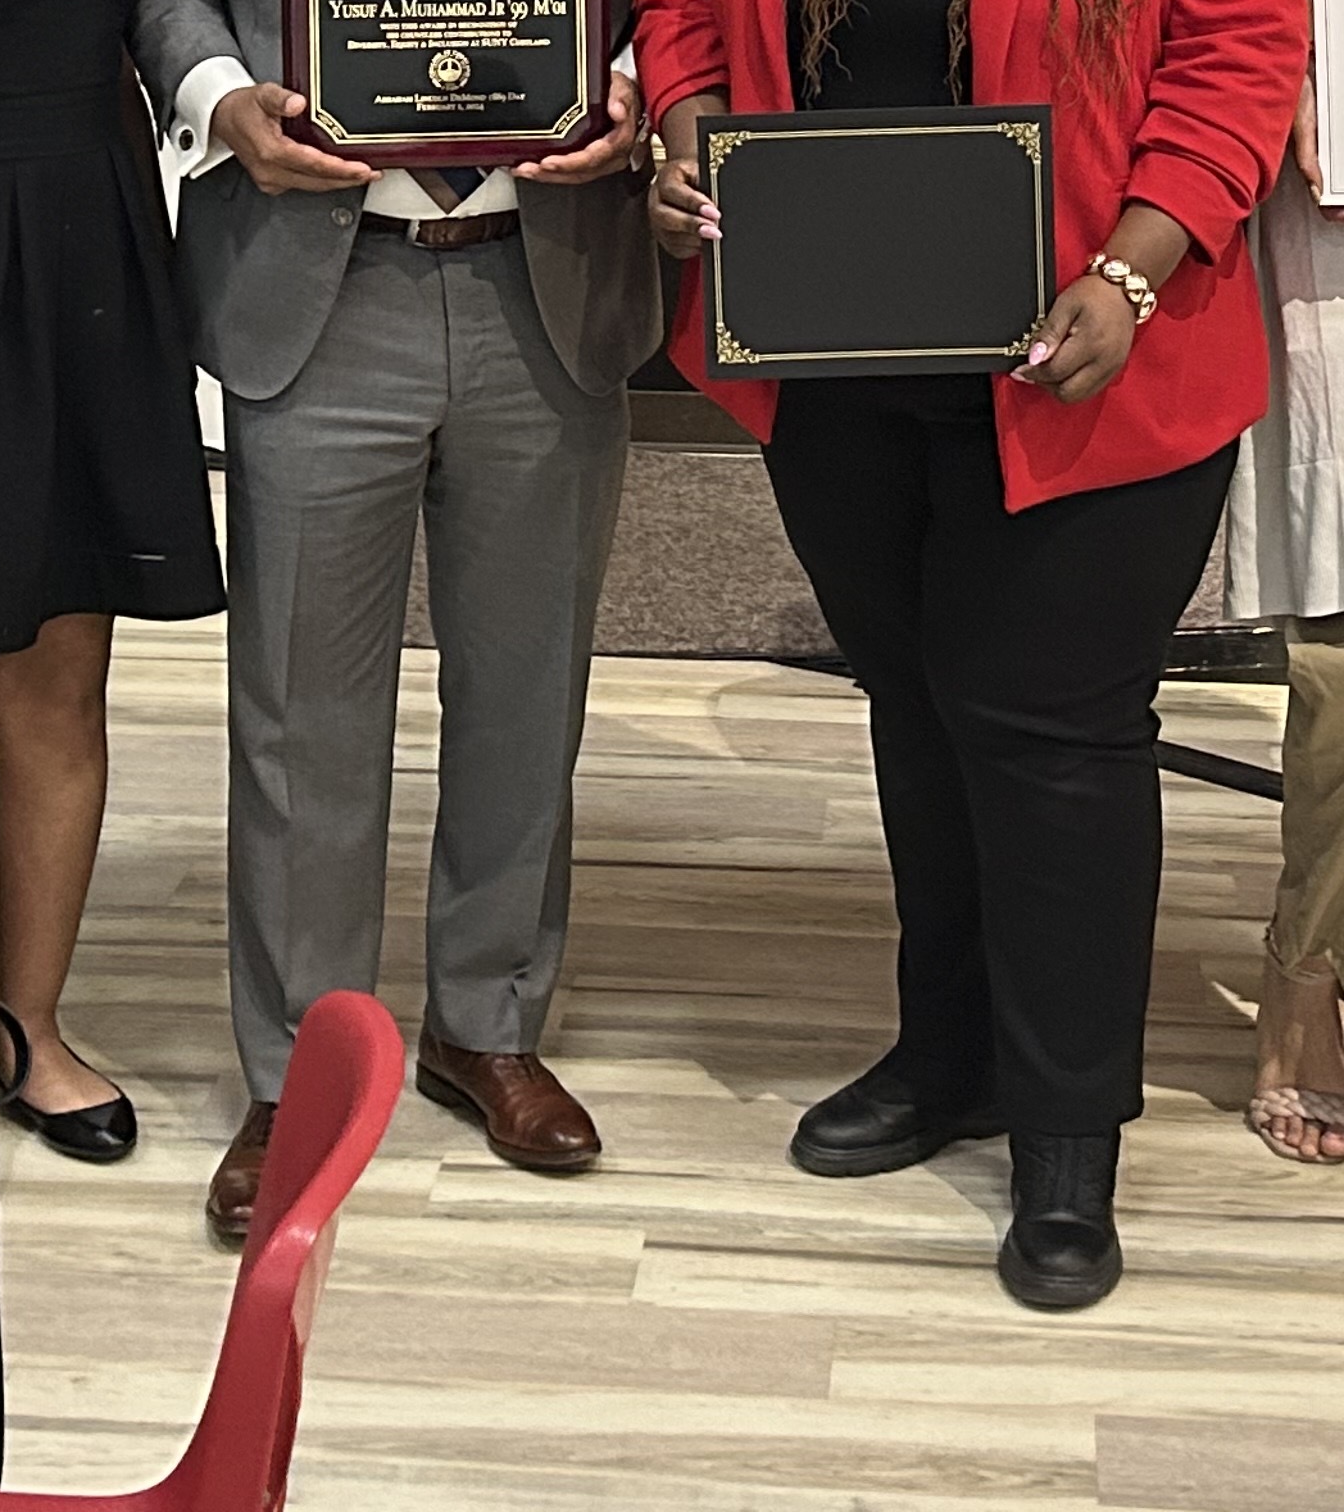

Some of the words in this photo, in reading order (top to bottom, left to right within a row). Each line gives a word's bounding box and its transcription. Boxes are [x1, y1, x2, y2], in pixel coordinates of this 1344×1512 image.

[328, 0, 378, 19] YUSUF
[380, 0, 399, 18] A.
[401, 0, 486, 18] MUHAMMAD
